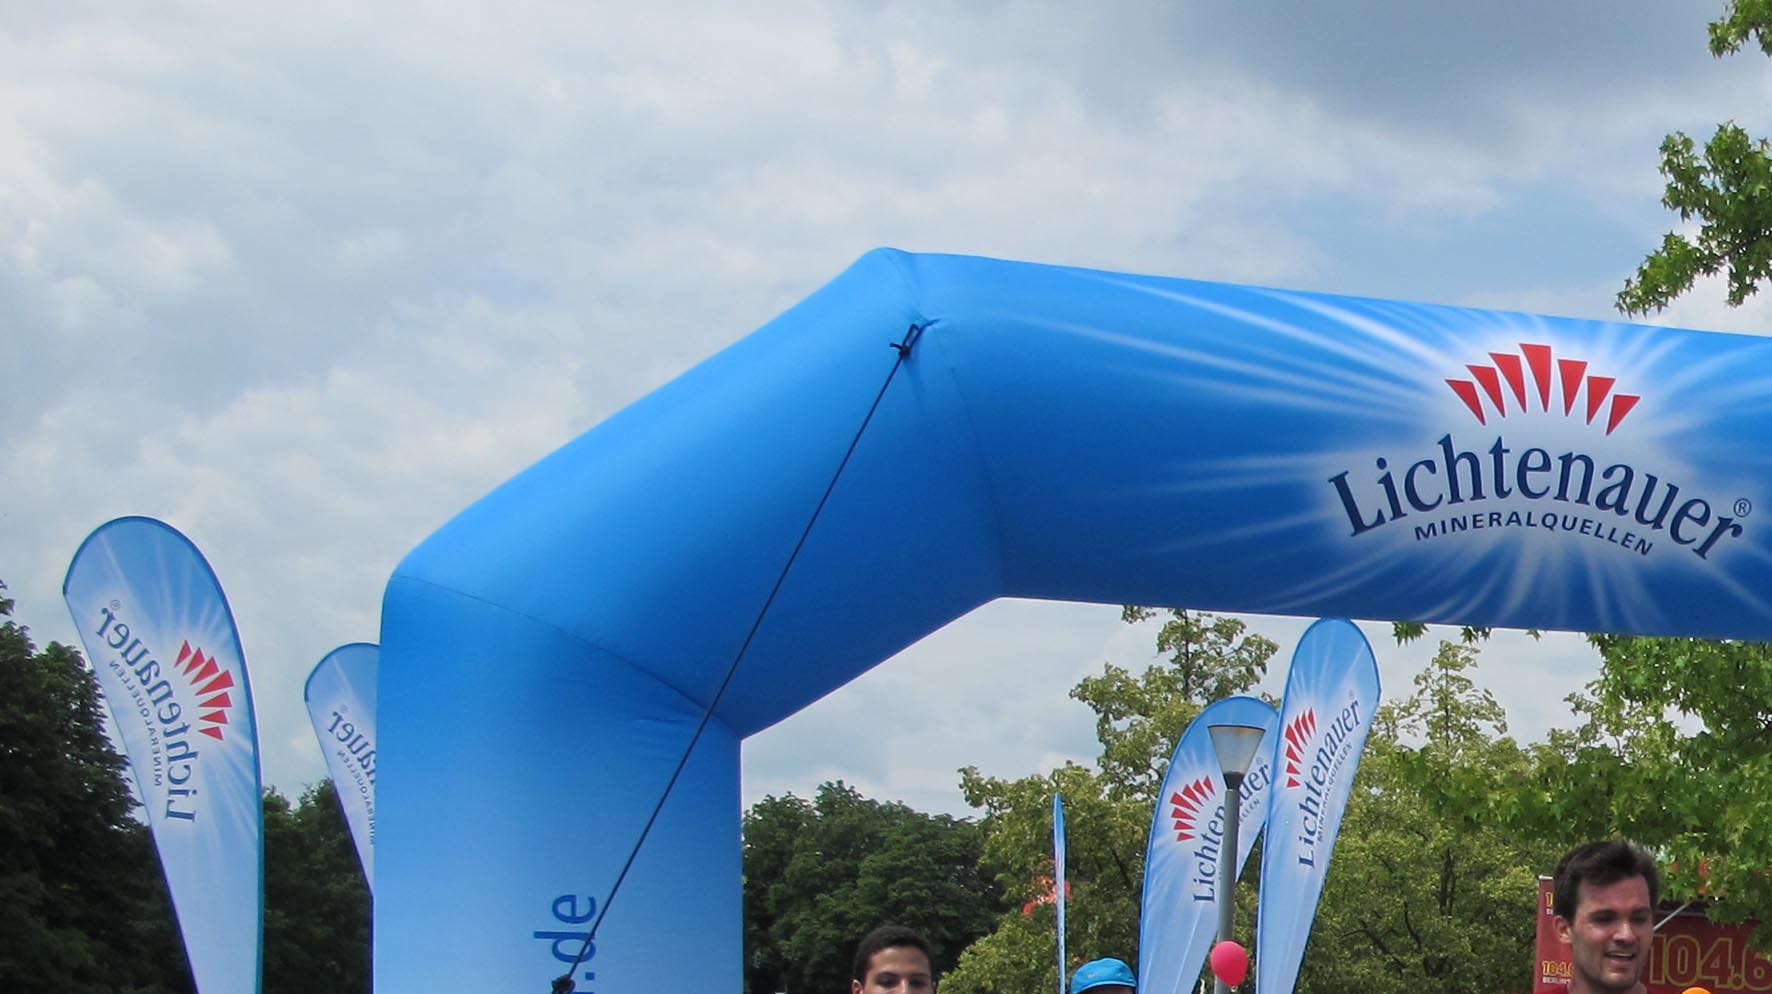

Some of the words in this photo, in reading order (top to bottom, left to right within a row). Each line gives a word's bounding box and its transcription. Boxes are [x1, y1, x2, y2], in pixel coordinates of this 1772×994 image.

[1328, 433, 1744, 560] Lichtenauer
[1414, 511, 1654, 557] MINERALQUELLEN
[1193, 763, 1271, 904] Lichtenuer
[1298, 698, 1361, 870] Lichtenauer
